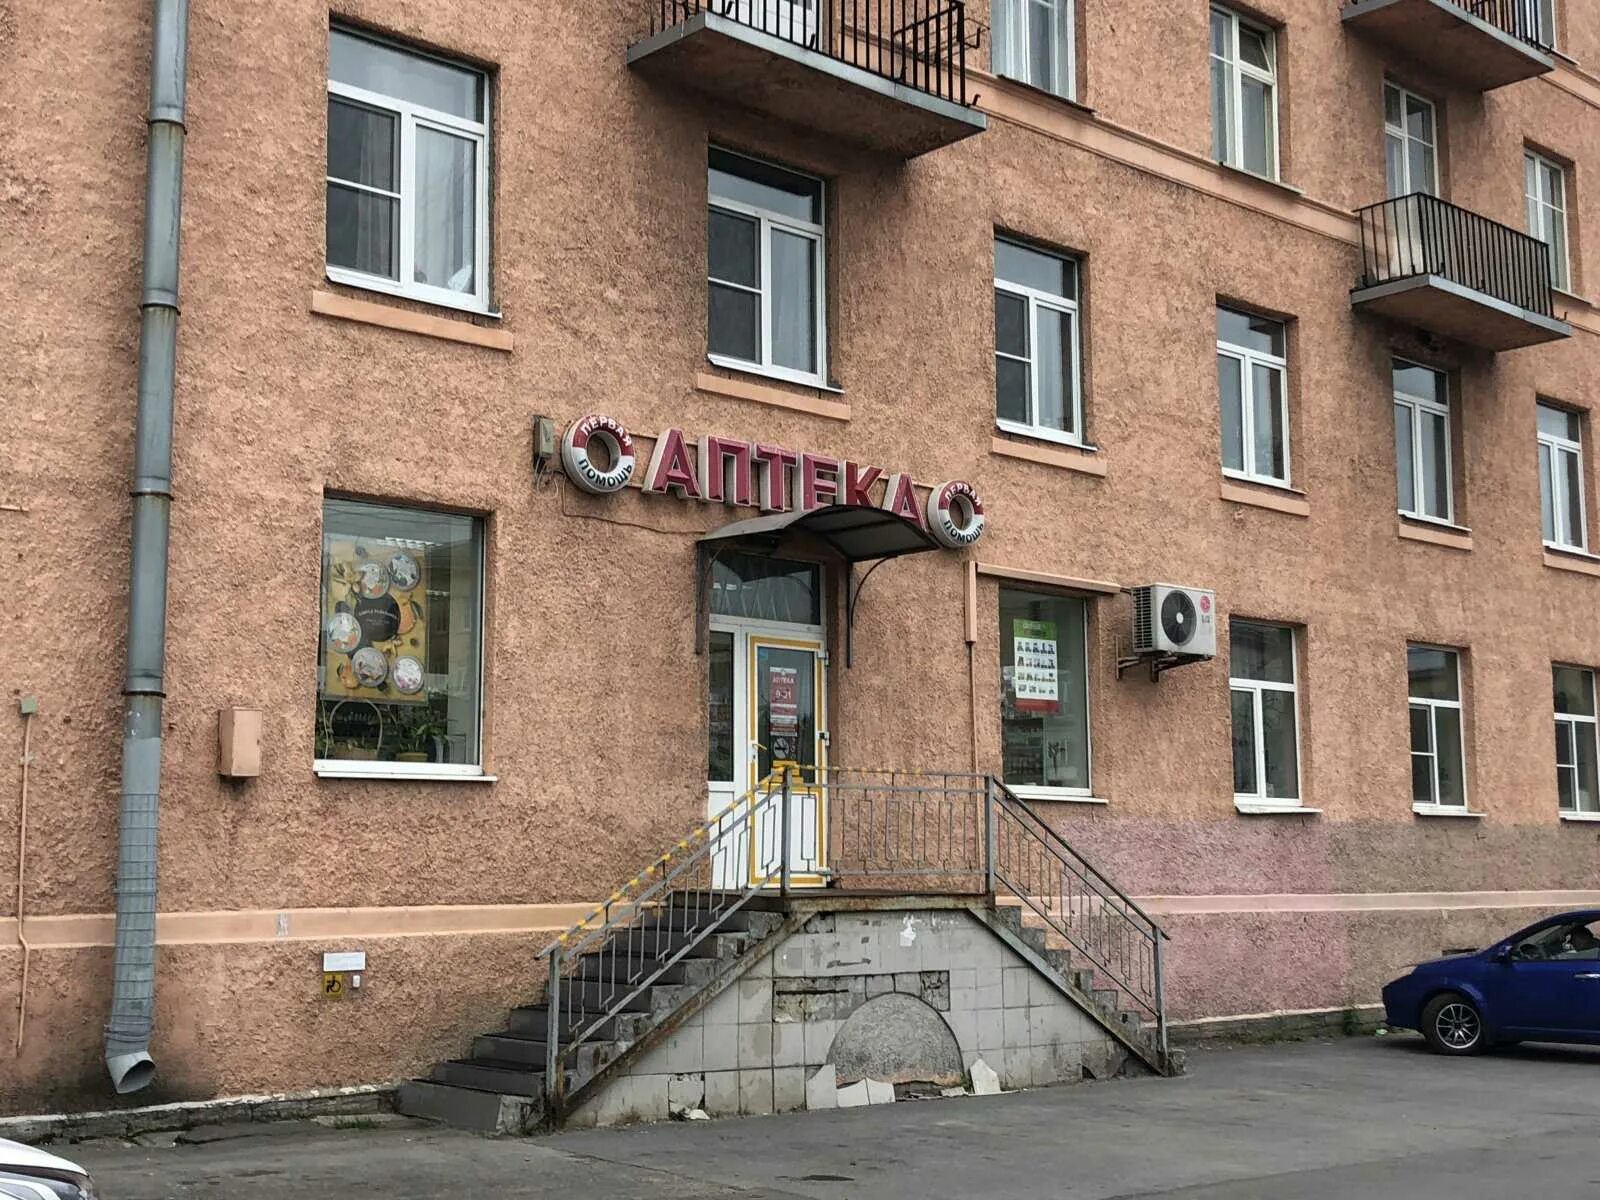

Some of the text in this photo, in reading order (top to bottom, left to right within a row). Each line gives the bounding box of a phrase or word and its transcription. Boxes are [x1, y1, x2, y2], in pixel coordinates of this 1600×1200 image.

[580, 415, 632, 446] ПЕРВАЯ
[579, 459, 632, 487] ПОМОЩЬ
[641, 427, 926, 529] АПТЕКА
[945, 482, 981, 506] ПЕРВАЯ
[944, 520, 983, 543] ПОМОЩЬ
